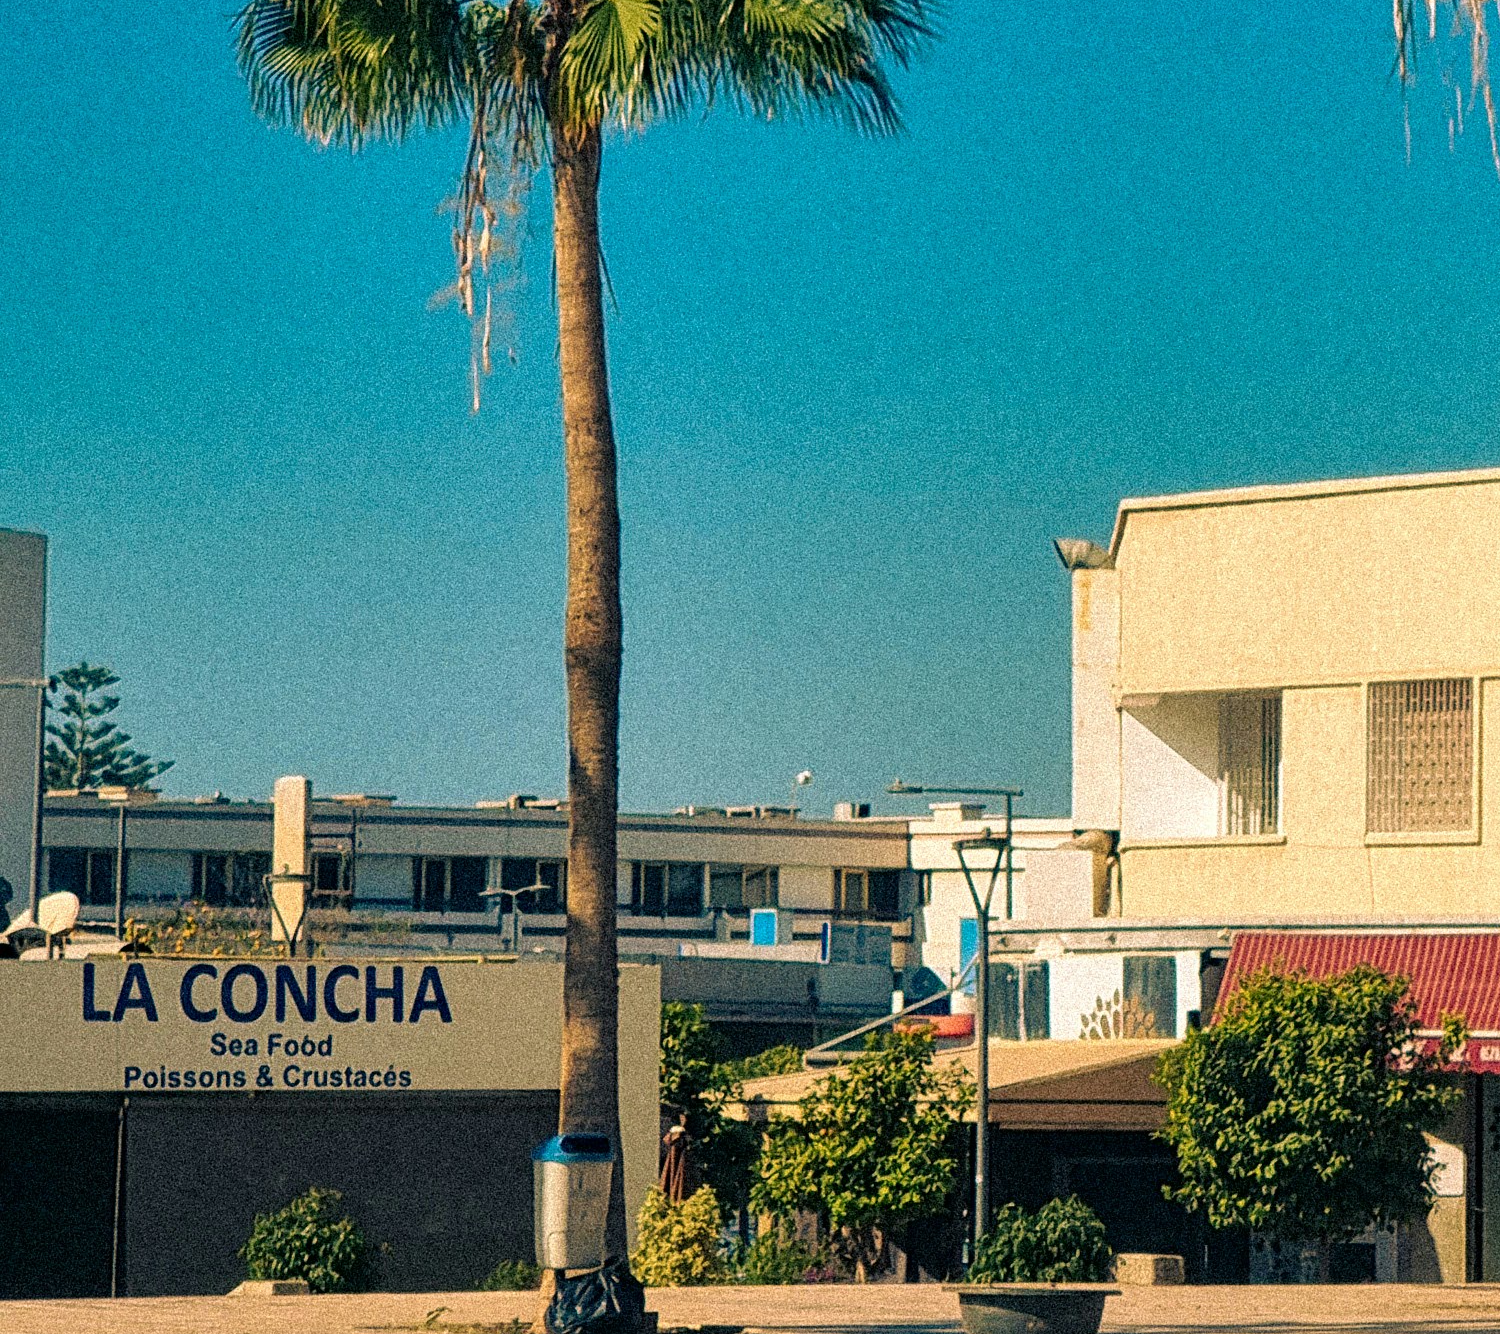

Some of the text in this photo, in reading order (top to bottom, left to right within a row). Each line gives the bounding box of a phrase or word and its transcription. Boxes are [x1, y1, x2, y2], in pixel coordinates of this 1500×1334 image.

[82, 962, 453, 1024] LA CONCHA
[210, 1032, 259, 1057] Sea
[124, 1064, 412, 1089] Poissons & Crustacés
